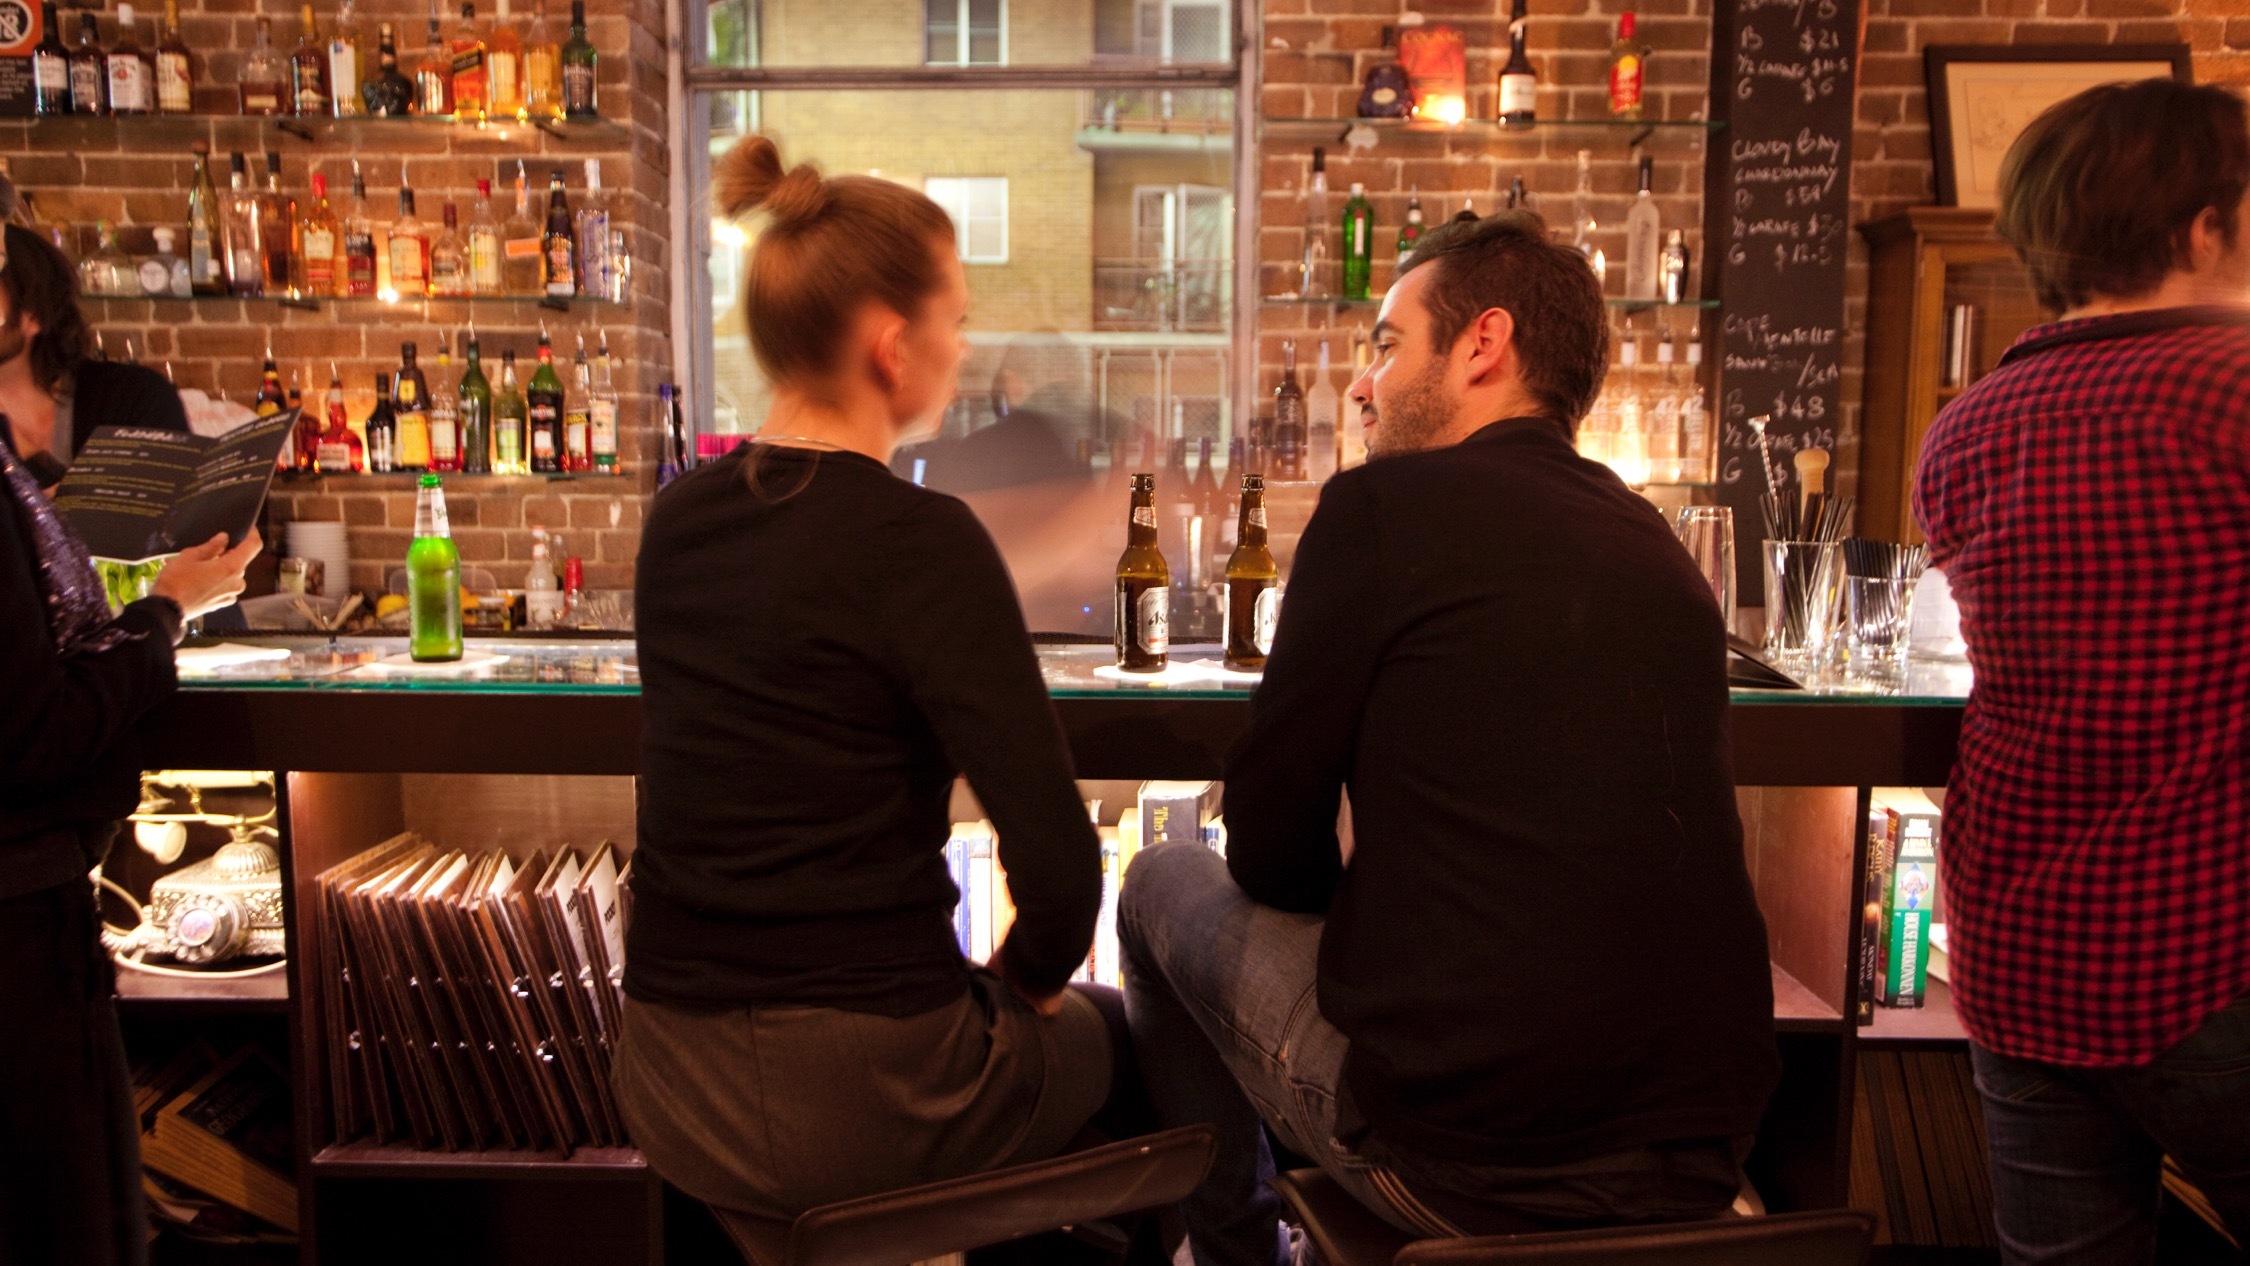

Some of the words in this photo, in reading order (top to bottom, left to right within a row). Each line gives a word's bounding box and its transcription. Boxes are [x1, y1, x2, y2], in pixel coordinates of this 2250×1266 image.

[1737, 77, 1753, 100] G
[1728, 242, 1746, 265] G
[1775, 390, 1826, 419] $48
[1723, 456, 1743, 484] G
[1153, 806, 1169, 831] The
[1904, 912, 1920, 940] HOUSE
